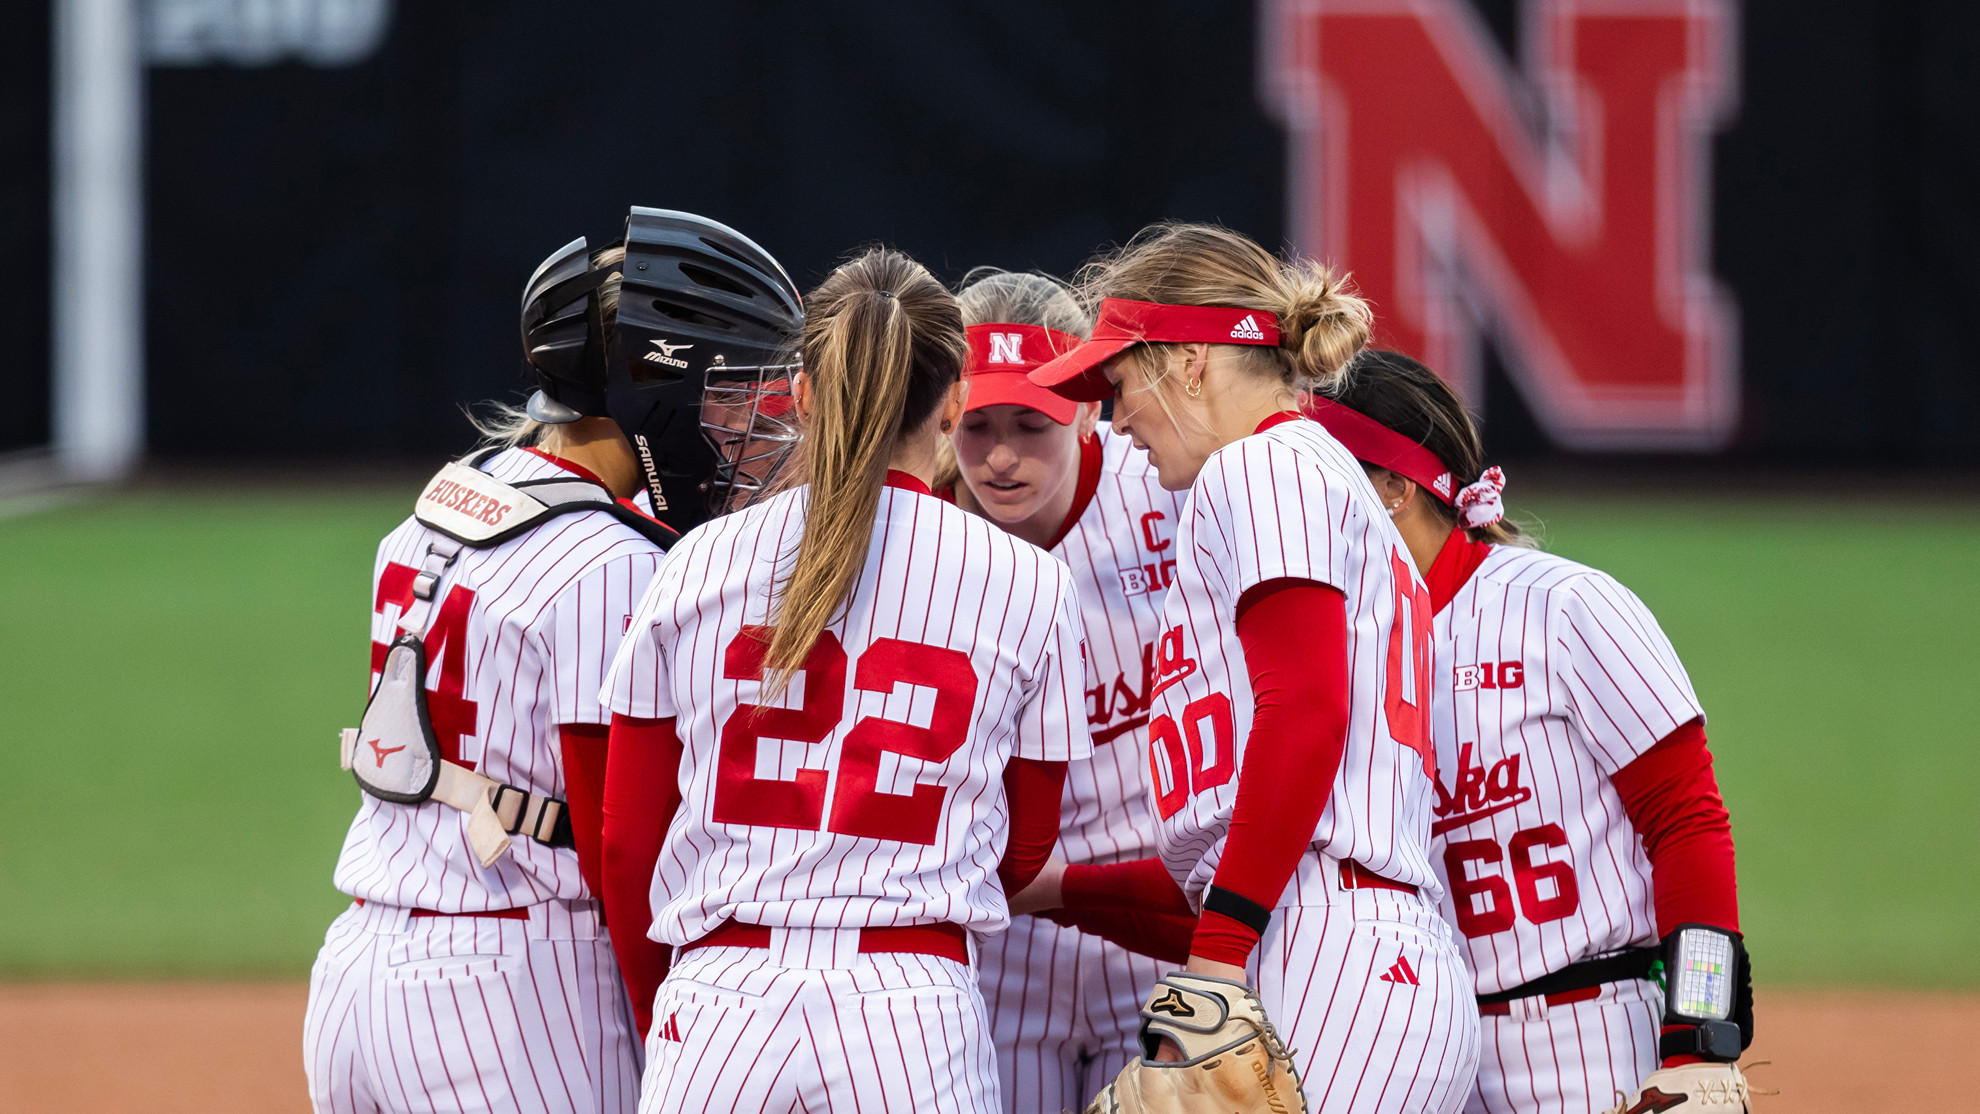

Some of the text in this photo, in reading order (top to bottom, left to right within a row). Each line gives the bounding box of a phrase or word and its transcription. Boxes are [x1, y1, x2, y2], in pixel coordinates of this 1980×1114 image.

[1258, 0, 1738, 450] N
[643, 351, 689, 369] MIZUNO
[988, 332, 1025, 365] N
[1230, 329, 1264, 340] adidas
[424, 478, 512, 526] HUSKERS
[634, 433, 669, 512] SAMURAI
[1140, 510, 1171, 553] C
[712, 624, 980, 846] 22
[1148, 691, 1236, 823] 00
[1443, 821, 1581, 939] 66
